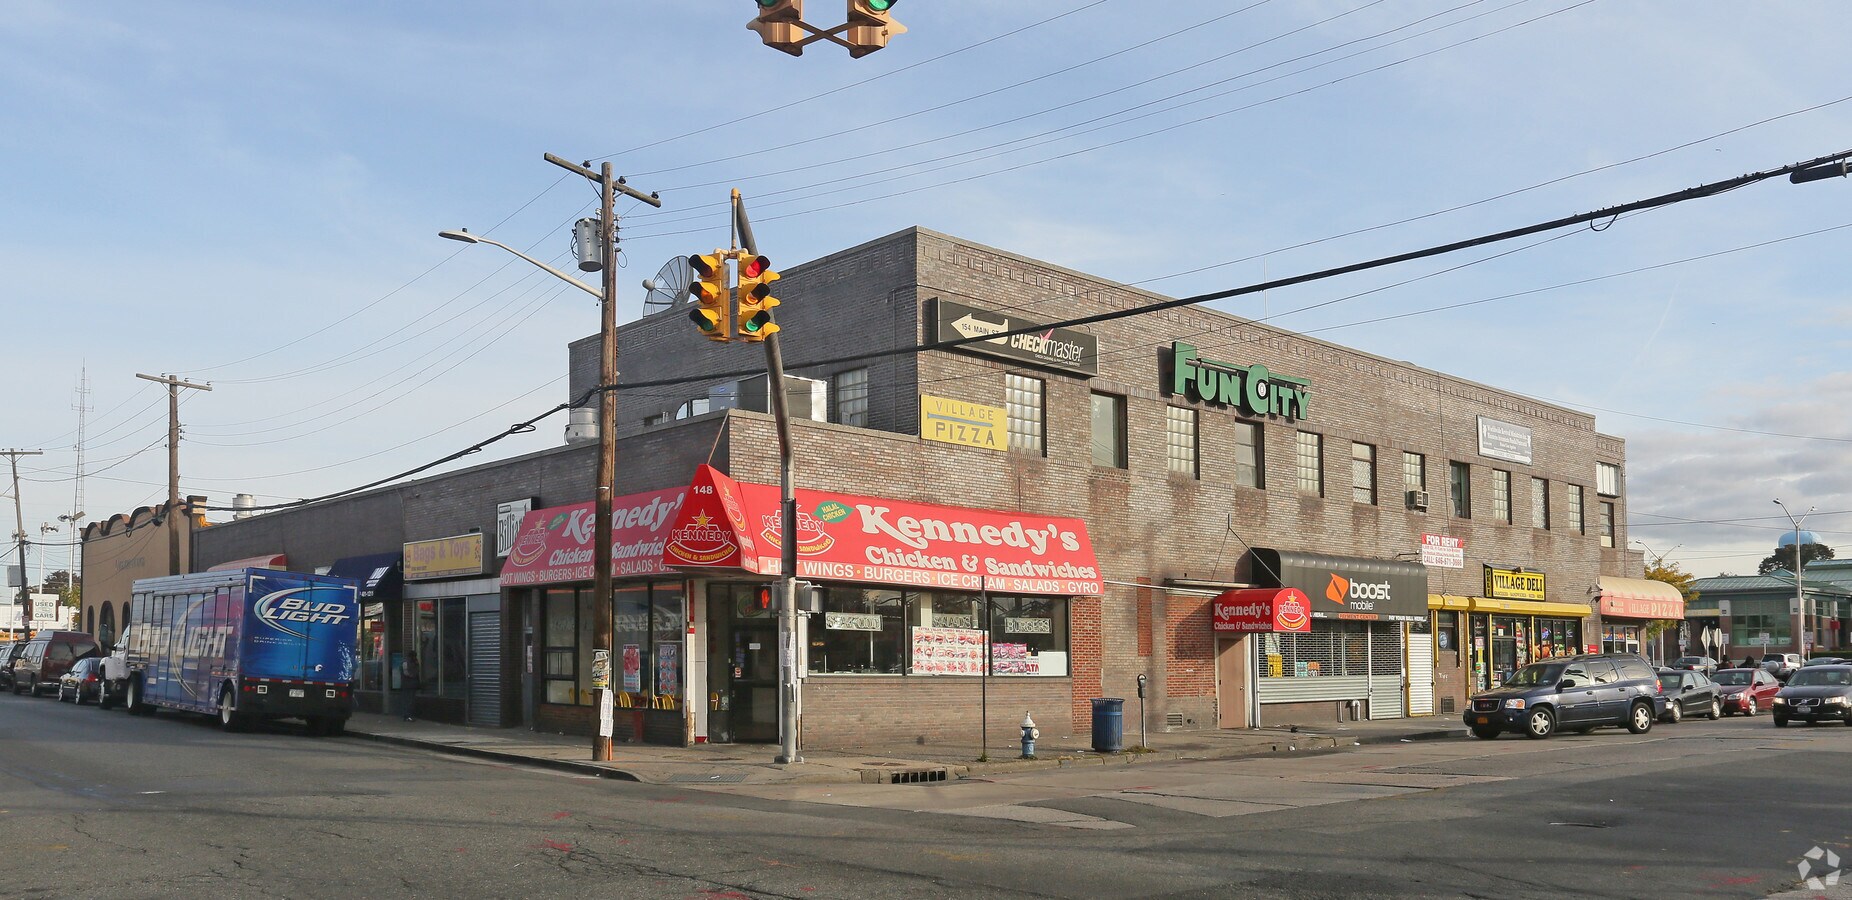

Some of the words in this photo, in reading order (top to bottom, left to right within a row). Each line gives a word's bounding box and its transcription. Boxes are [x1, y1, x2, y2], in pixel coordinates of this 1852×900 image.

[961, 323, 971, 331] 154
[974, 326, 989, 335] MAIN
[1246, 364, 1311, 420] CITY
[936, 401, 993, 420] VILLAGE
[936, 422, 994, 446] PIZZA
[693, 486, 713, 494] 148
[821, 503, 839, 513] HALAL
[822, 508, 846, 521] CHICKEN
[562, 493, 684, 544] Kenedy'
[671, 529, 731, 541] KENNEDY
[855, 504, 1080, 555] Kennedy's
[1426, 535, 1440, 546] FOR
[1442, 537, 1458, 548] RENT
[413, 543, 436, 564] Bags
[439, 541, 446, 559] &
[448, 539, 470, 558] Toys
[549, 546, 594, 566] Chicken
[670, 545, 692, 559] CHICKEN
[699, 546, 734, 561] SANDWICHES
[865, 545, 958, 571] Chicken
[961, 554, 979, 572] &
[984, 557, 1097, 579] Sandwiches
[500, 573, 513, 584] HOT
[514, 571, 536, 583] WINGS
[540, 568, 572, 581] BURGERS
[575, 566, 587, 578] ICE
[620, 559, 653, 575] SALADS
[803, 561, 854, 577] WINGS
[864, 566, 930, 584] BURGERS
[937, 573, 959, 586] ICE
[1013, 579, 1060, 592] SALADS
[1068, 582, 1099, 594] GYRO
[1350, 577, 1391, 600] boost
[1494, 574, 1525, 590] VILLAGE
[1527, 577, 1543, 592] DELI
[279, 598, 345, 614] BUD
[1214, 602, 1270, 620] Kennedy's
[1279, 605, 1304, 614] KENNEDY
[1350, 601, 1374, 610] mobile
[1651, 603, 1680, 617] PIZZA
[263, 608, 350, 624] LIGHT
[1214, 622, 1235, 630] Chicken
[1236, 622, 1241, 630] &
[1242, 622, 1272, 630] Sandwiches
[175, 624, 234, 658] LIGHT
